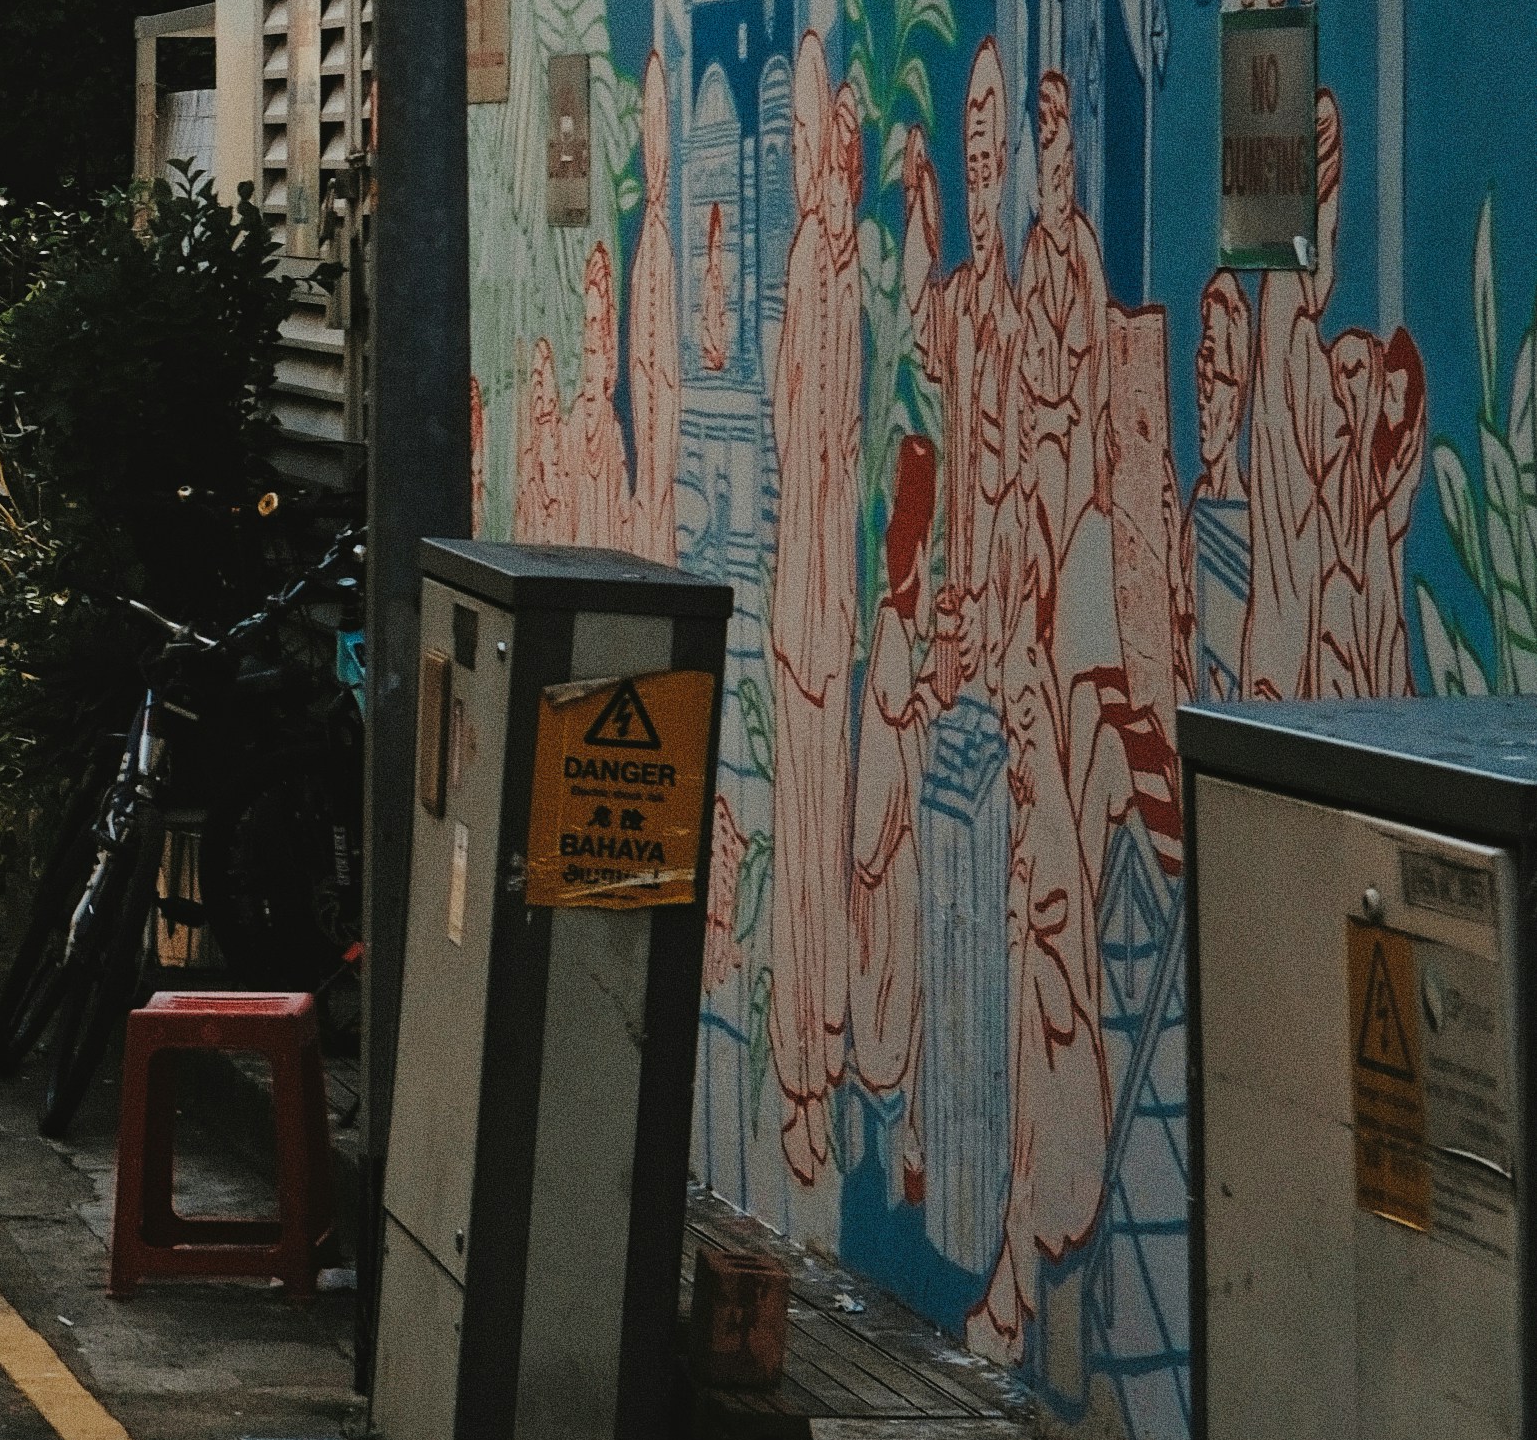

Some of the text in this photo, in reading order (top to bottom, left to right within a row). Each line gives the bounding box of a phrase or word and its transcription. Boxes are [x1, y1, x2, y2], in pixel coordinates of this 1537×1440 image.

[1250, 53, 1280, 114] NO
[564, 755, 677, 787] DANGER
[560, 833, 666, 864] BAHAYA
